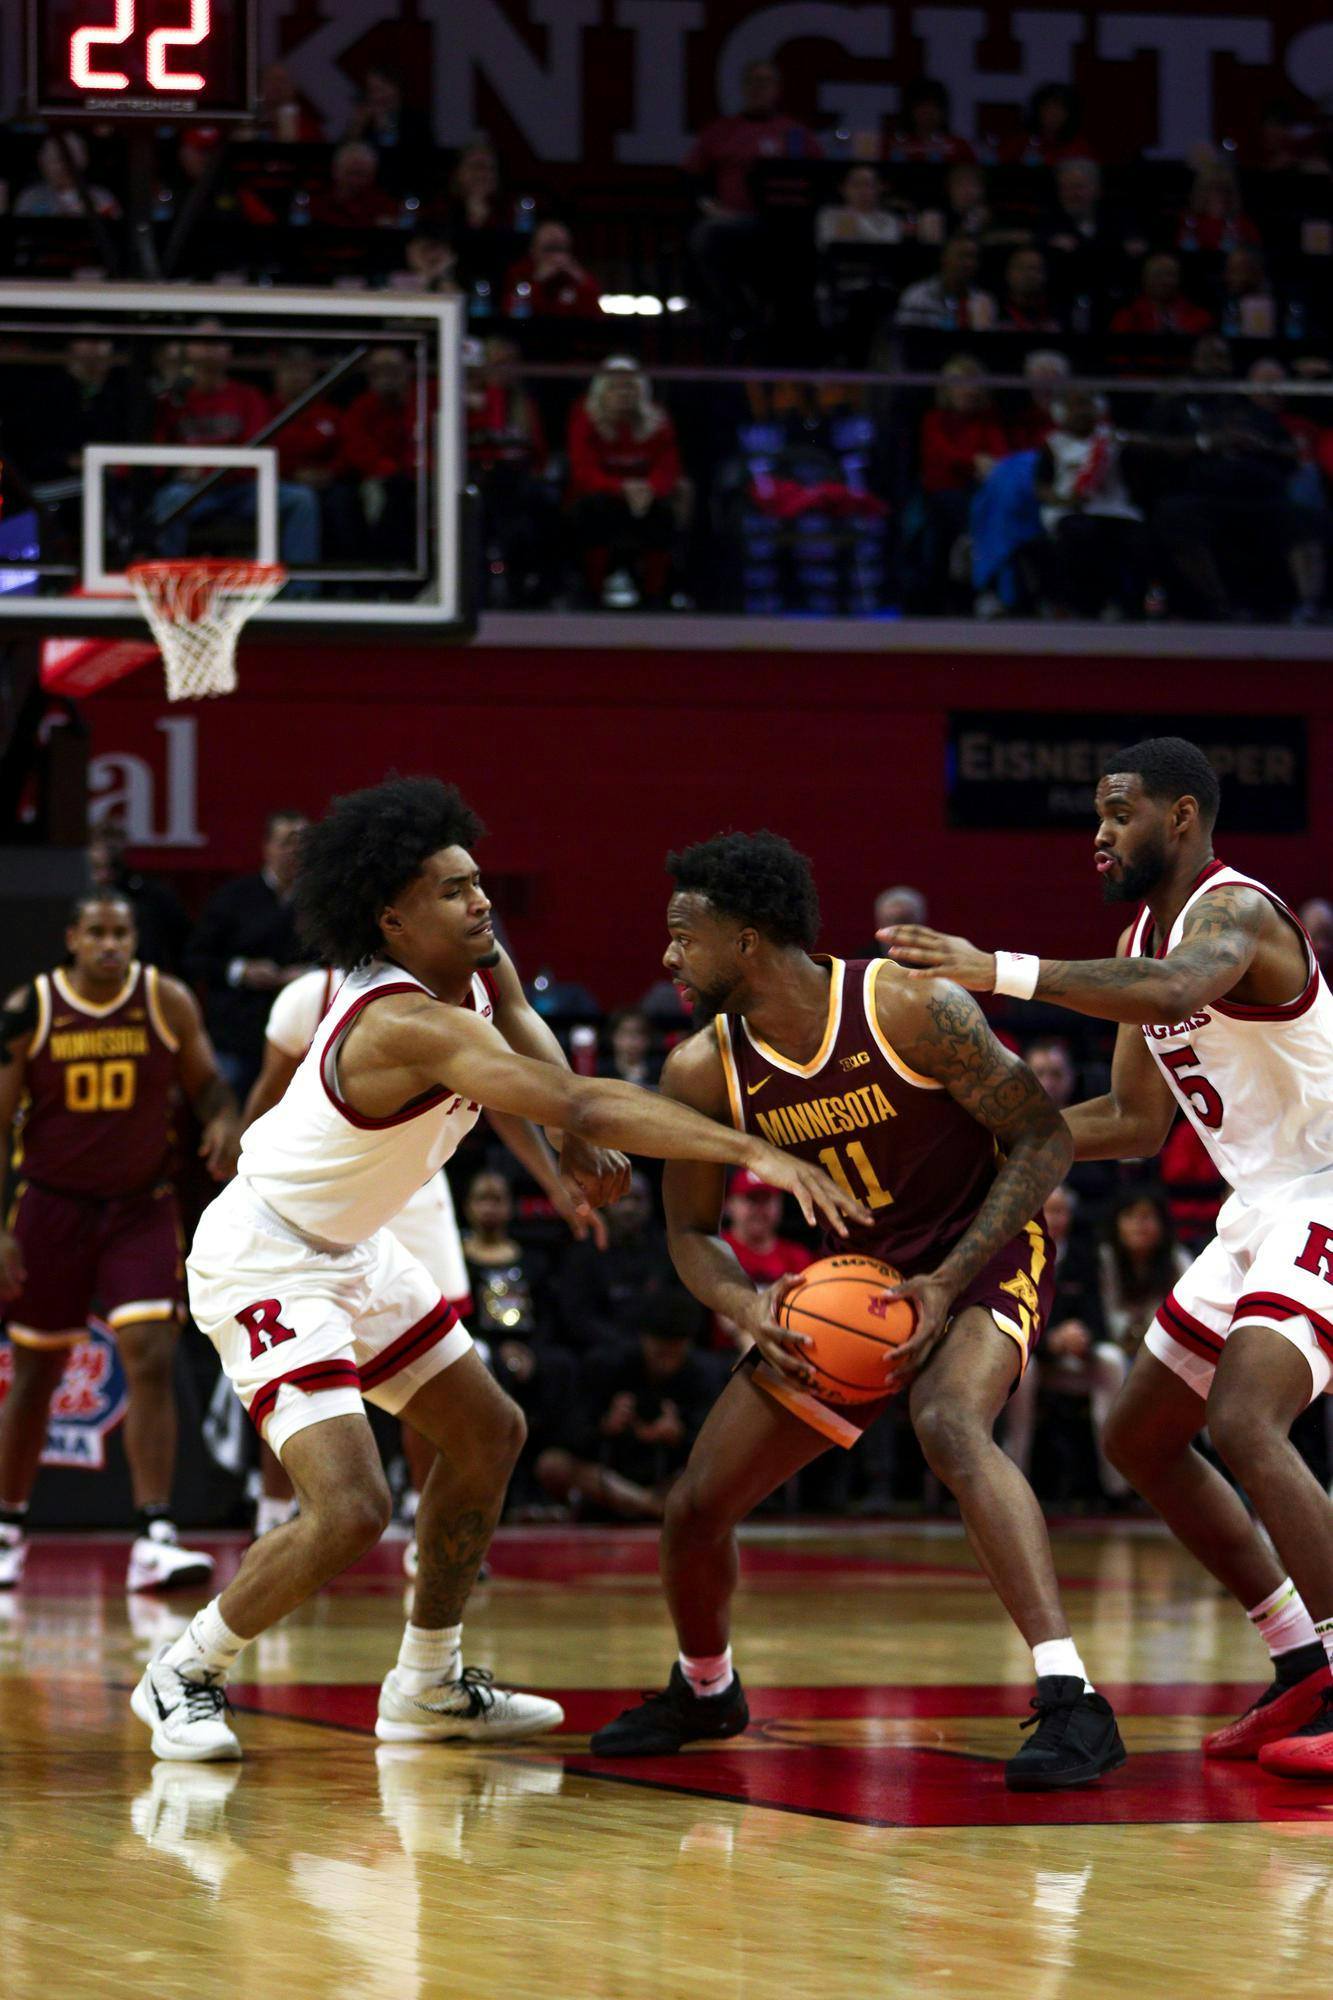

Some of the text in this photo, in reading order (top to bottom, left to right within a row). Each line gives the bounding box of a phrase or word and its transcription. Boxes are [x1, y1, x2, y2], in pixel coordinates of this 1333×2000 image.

[69, 0, 210, 90] 22
[65, 1058, 137, 1112] 00
[756, 1082, 899, 1147] MINNESOTA
[1159, 1044, 1224, 1129] 5
[818, 1140, 895, 1212] 11
[235, 1298, 297, 1361] R
